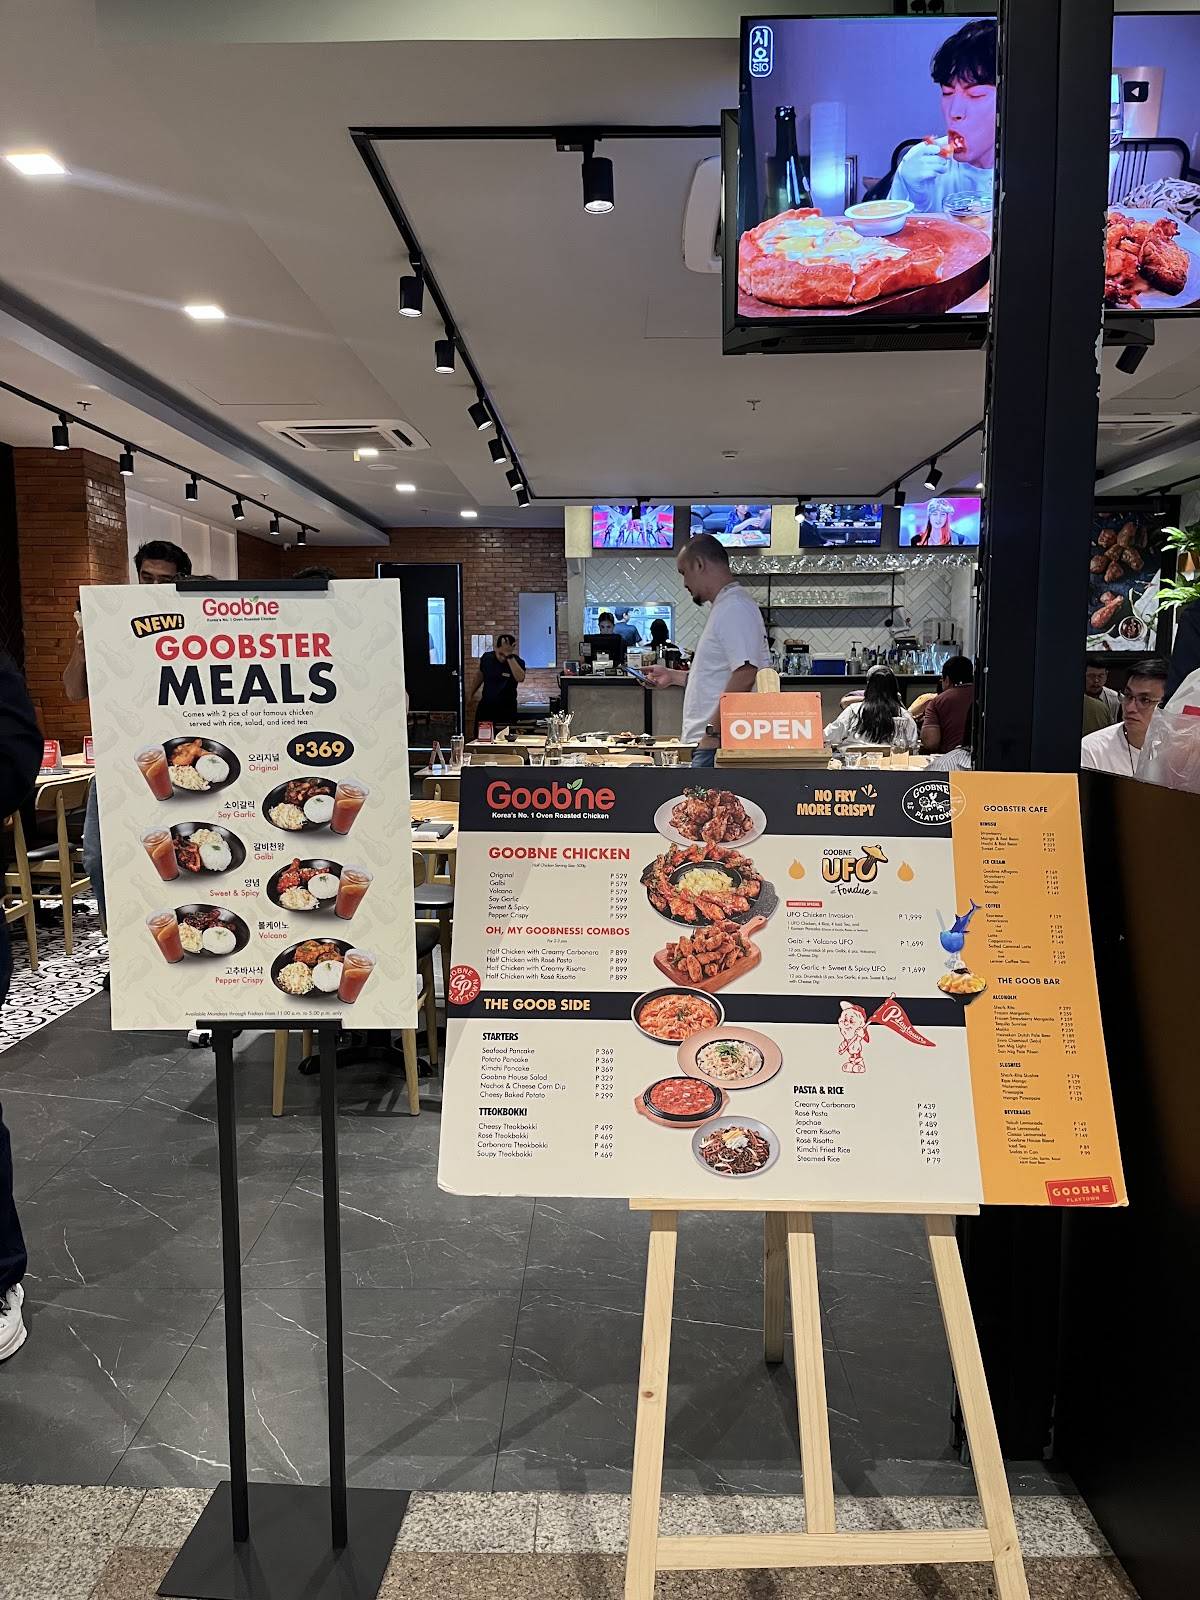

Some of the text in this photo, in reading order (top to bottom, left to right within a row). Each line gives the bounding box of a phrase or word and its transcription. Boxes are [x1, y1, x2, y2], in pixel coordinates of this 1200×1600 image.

[752, 29, 769, 63] 시오
[753, 63, 769, 72] SIO
[202, 598, 280, 617] Goobne
[134, 615, 184, 635] NEW!
[155, 633, 332, 661] GOOBSTER
[158, 662, 337, 706] MEALS
[207, 710, 220, 718] with
[228, 711, 240, 720] pcs
[287, 709, 314, 717] chicken
[228, 720, 243, 728] rice,
[245, 719, 265, 728] salad,
[730, 720, 812, 740] OPEN
[248, 753, 280, 763] 오리지널
[249, 764, 279, 773] Original
[486, 781, 616, 811] Goobne
[814, 789, 856, 802] NO FRY
[913, 785, 950, 798] GOOBNE
[224, 801, 255, 810] 소이갈릭
[797, 803, 875, 817] MORE CRISPY
[218, 810, 256, 819] Soy Garlic
[583, 812, 609, 820] Chicken
[915, 807, 957, 821] PLAYTOWN
[253, 842, 285, 852] 갈비천왕
[254, 853, 274, 861] Galbi
[489, 847, 630, 860] GOOBNE CHICKEN
[822, 857, 878, 882] UFO
[490, 871, 515, 879] Original
[210, 889, 231, 897] Sweet
[241, 889, 260, 898] Spicy
[835, 883, 871, 896] Fondue
[514, 904, 530, 912] Spicy
[258, 921, 289, 931] 볼케이노
[259, 932, 288, 940] Volcano
[486, 927, 630, 936] OH, MY GOOBNESS! COMBOS
[541, 949, 566, 957] Creamy
[225, 966, 264, 975] 고추바사삭
[788, 964, 799, 972] Soy
[855, 965, 871, 973] Spicy
[215, 977, 264, 985] Pepper Crispy
[484, 999, 591, 1011] THE GOOB SIDE
[882, 1005, 926, 1045] Playtown
[482, 1033, 519, 1041] STARTERS
[555, 1083, 566, 1091] Dip
[794, 1086, 845, 1095] PASTA & RICE
[480, 1091, 503, 1099] Cheesy
[794, 1101, 819, 1109] Creamy
[479, 1108, 527, 1116] TTEOKBOKKI
[795, 1109, 810, 1117] Rosé
[478, 1123, 502, 1131] Cheesy
[797, 1155, 826, 1163] Steamed
[1052, 1185, 1110, 1197] GOOBNE
